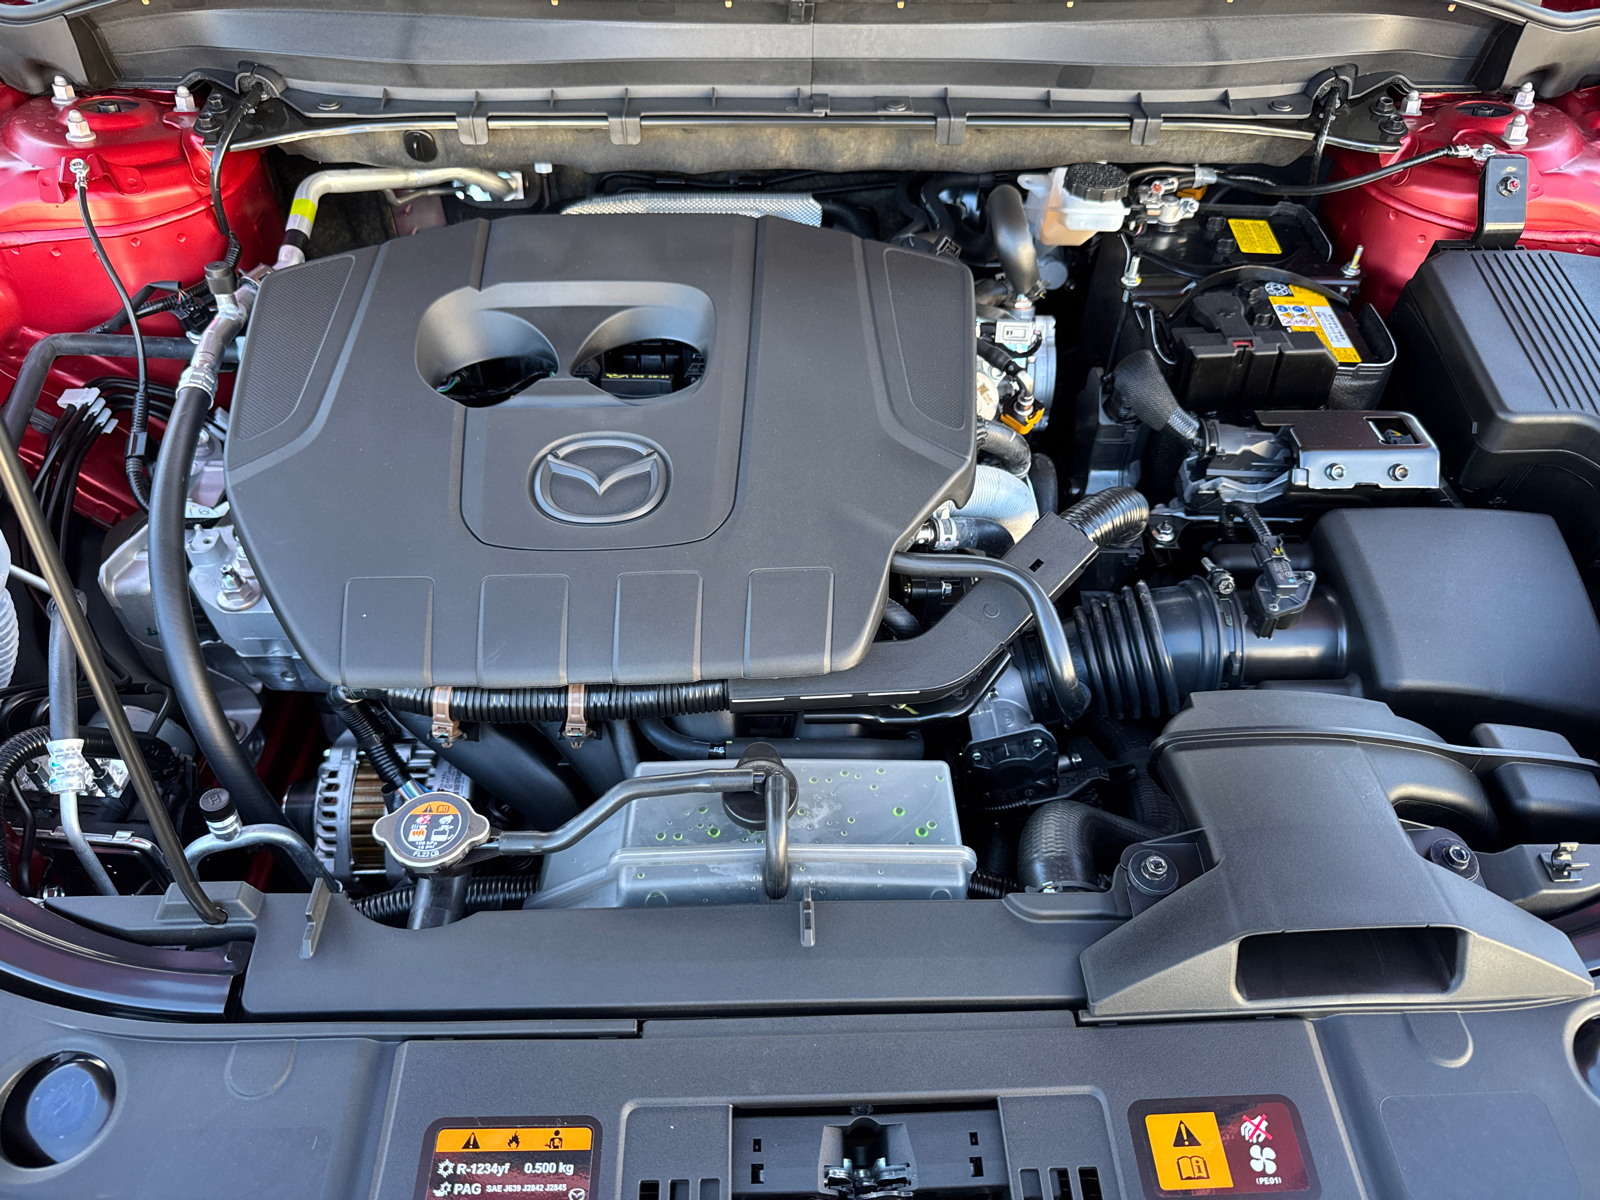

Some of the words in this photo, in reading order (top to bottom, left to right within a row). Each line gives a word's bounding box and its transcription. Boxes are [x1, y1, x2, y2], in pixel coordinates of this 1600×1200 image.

[456, 1163, 510, 1176] R-1234yf
[524, 1162, 556, 1174] 0.500
[558, 1162, 574, 1176] kg
[453, 1183, 481, 1195] PAG
[485, 1184, 502, 1193] SAE
[503, 1184, 521, 1193] J639
[522, 1184, 544, 1192] J2842
[544, 1184, 567, 1192] J2845
